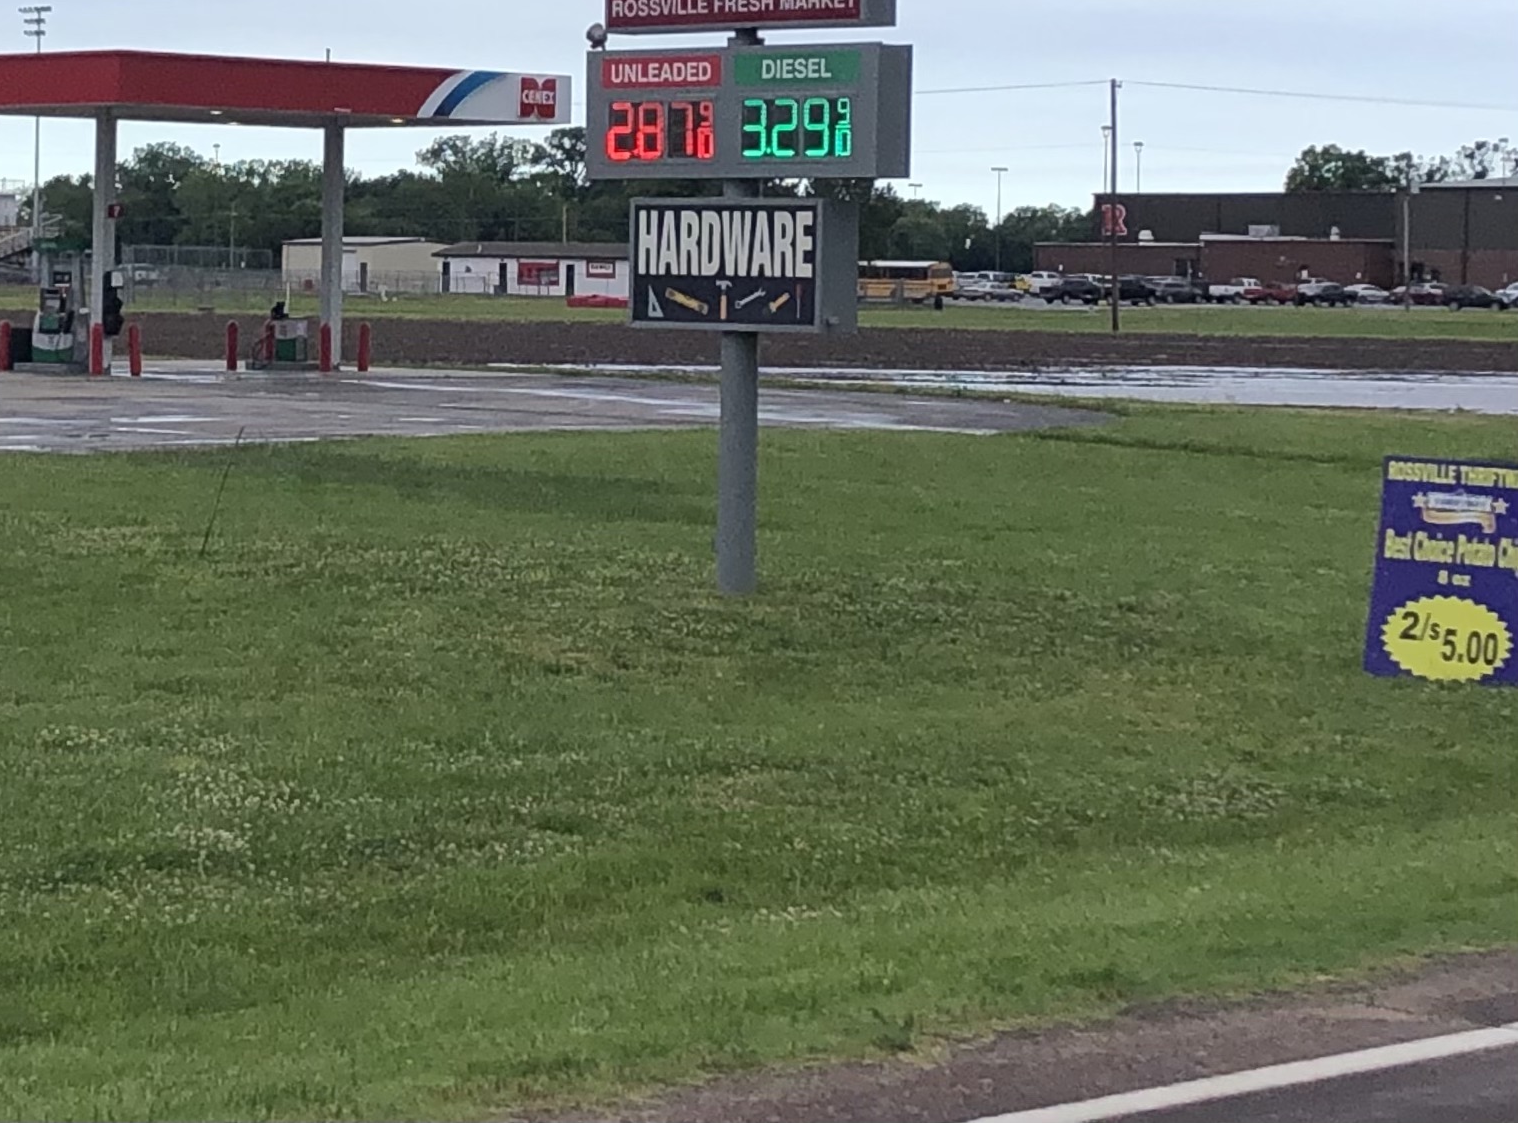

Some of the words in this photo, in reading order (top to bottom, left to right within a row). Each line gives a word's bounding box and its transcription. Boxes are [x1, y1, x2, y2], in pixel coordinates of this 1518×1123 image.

[610, 61, 712, 83] UNLEADED
[761, 58, 832, 79] DIESEL
[522, 89, 555, 106] CENEX
[1101, 204, 1128, 236] R
[638, 209, 814, 278] HARDWARE
[1387, 461, 1457, 484] ROSSVILLE
[1460, 465, 1518, 489] THRIFTW
[1414, 531, 1455, 563] Choice
